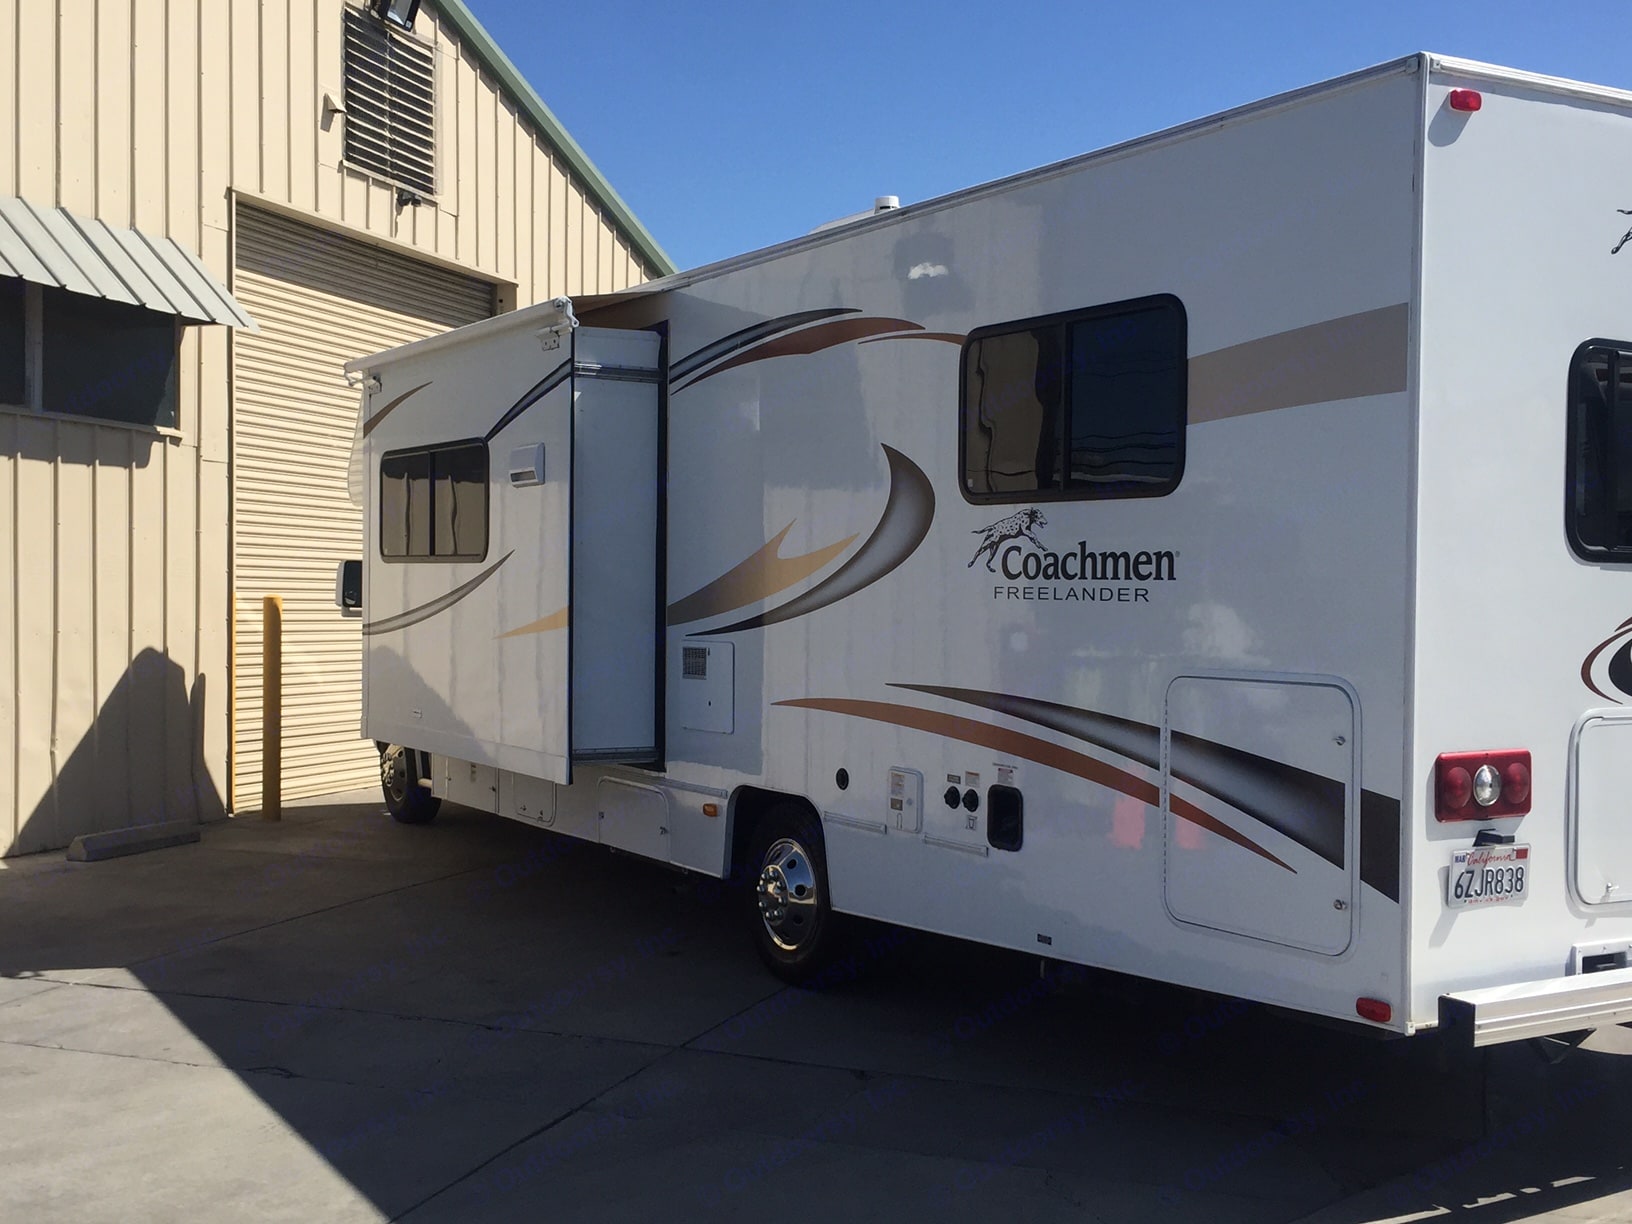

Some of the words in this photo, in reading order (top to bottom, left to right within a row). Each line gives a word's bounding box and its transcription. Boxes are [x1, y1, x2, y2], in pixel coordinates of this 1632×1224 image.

[1002, 541, 1177, 581] Coachmen
[993, 586, 1150, 602] FREELANDER
[1467, 851, 1516, 867] California
[1454, 866, 1524, 899] 6ZJR838
